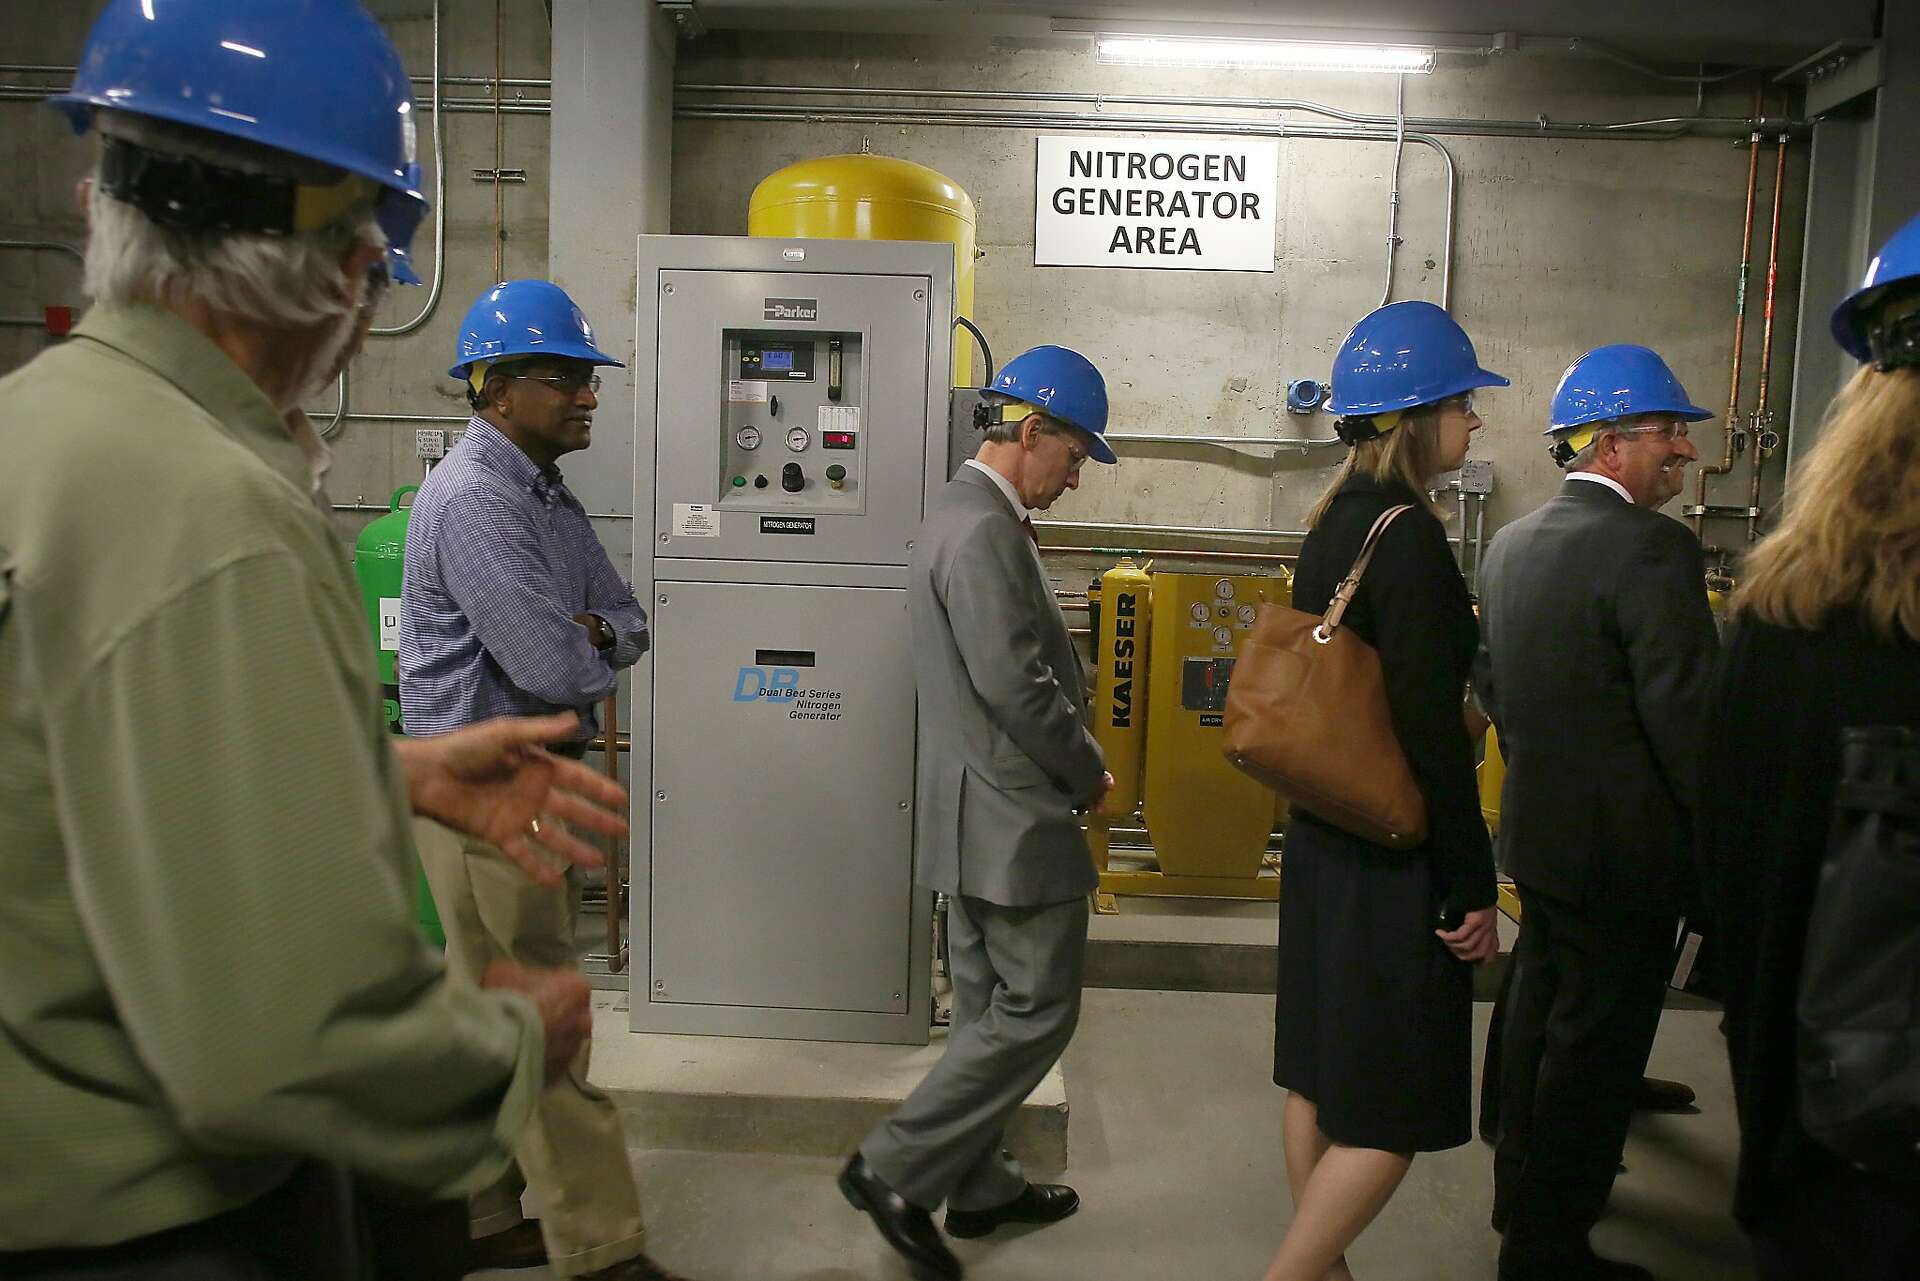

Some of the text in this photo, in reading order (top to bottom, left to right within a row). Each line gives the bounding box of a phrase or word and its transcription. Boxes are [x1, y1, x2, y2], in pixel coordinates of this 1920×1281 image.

[1069, 150, 1246, 181] NITROGEN
[1052, 187, 1260, 219] GENERATOR
[1108, 226, 1202, 255] AREA
[774, 304, 816, 318] Parker
[786, 521, 812, 529] GENERATOR
[1112, 593, 1136, 727] KAESER
[734, 667, 800, 703] DB
[759, 687, 841, 699] Dual Bed Series
[789, 710, 841, 720] Generator
[796, 700, 841, 711] Nitrogen
